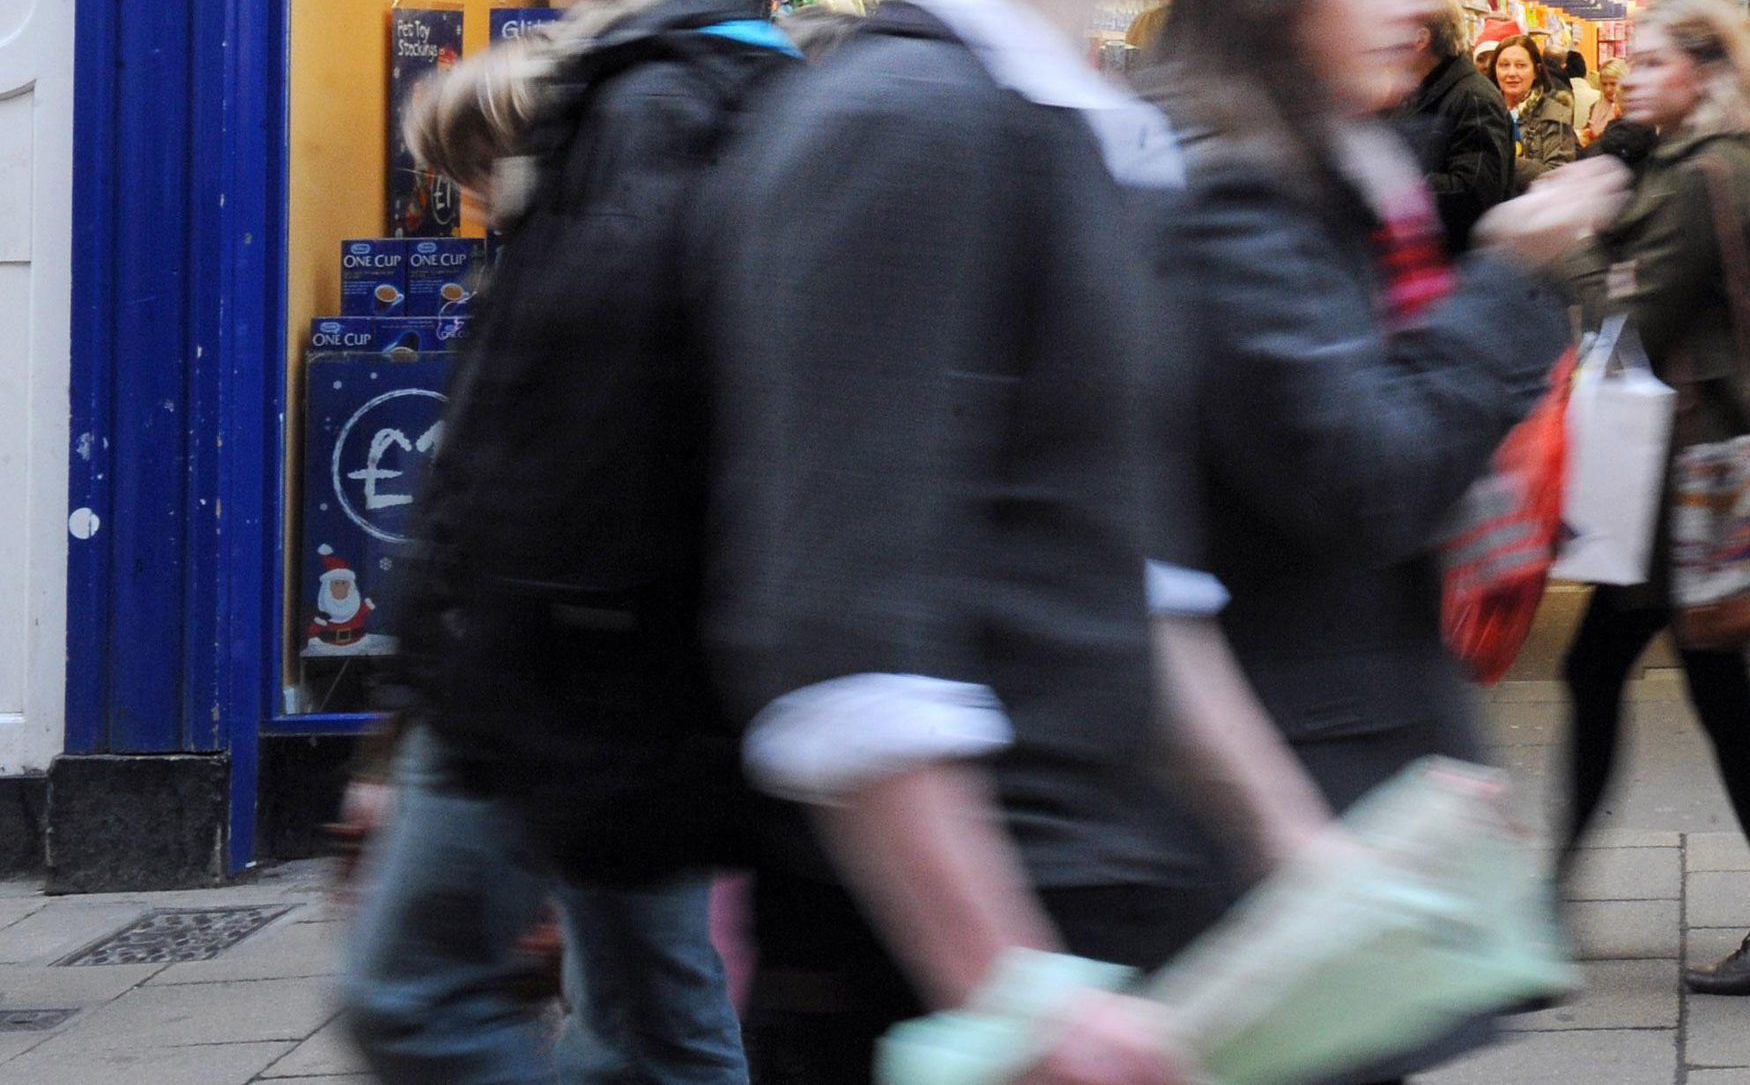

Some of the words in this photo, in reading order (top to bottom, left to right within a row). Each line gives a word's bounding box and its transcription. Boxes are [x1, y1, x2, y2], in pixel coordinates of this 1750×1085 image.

[343, 254, 372, 268] ONE
[374, 254, 402, 268] CUP
[410, 253, 438, 267] ONE
[440, 252, 467, 266] CUP
[312, 333, 341, 346] ONE
[344, 332, 372, 345] CUP
